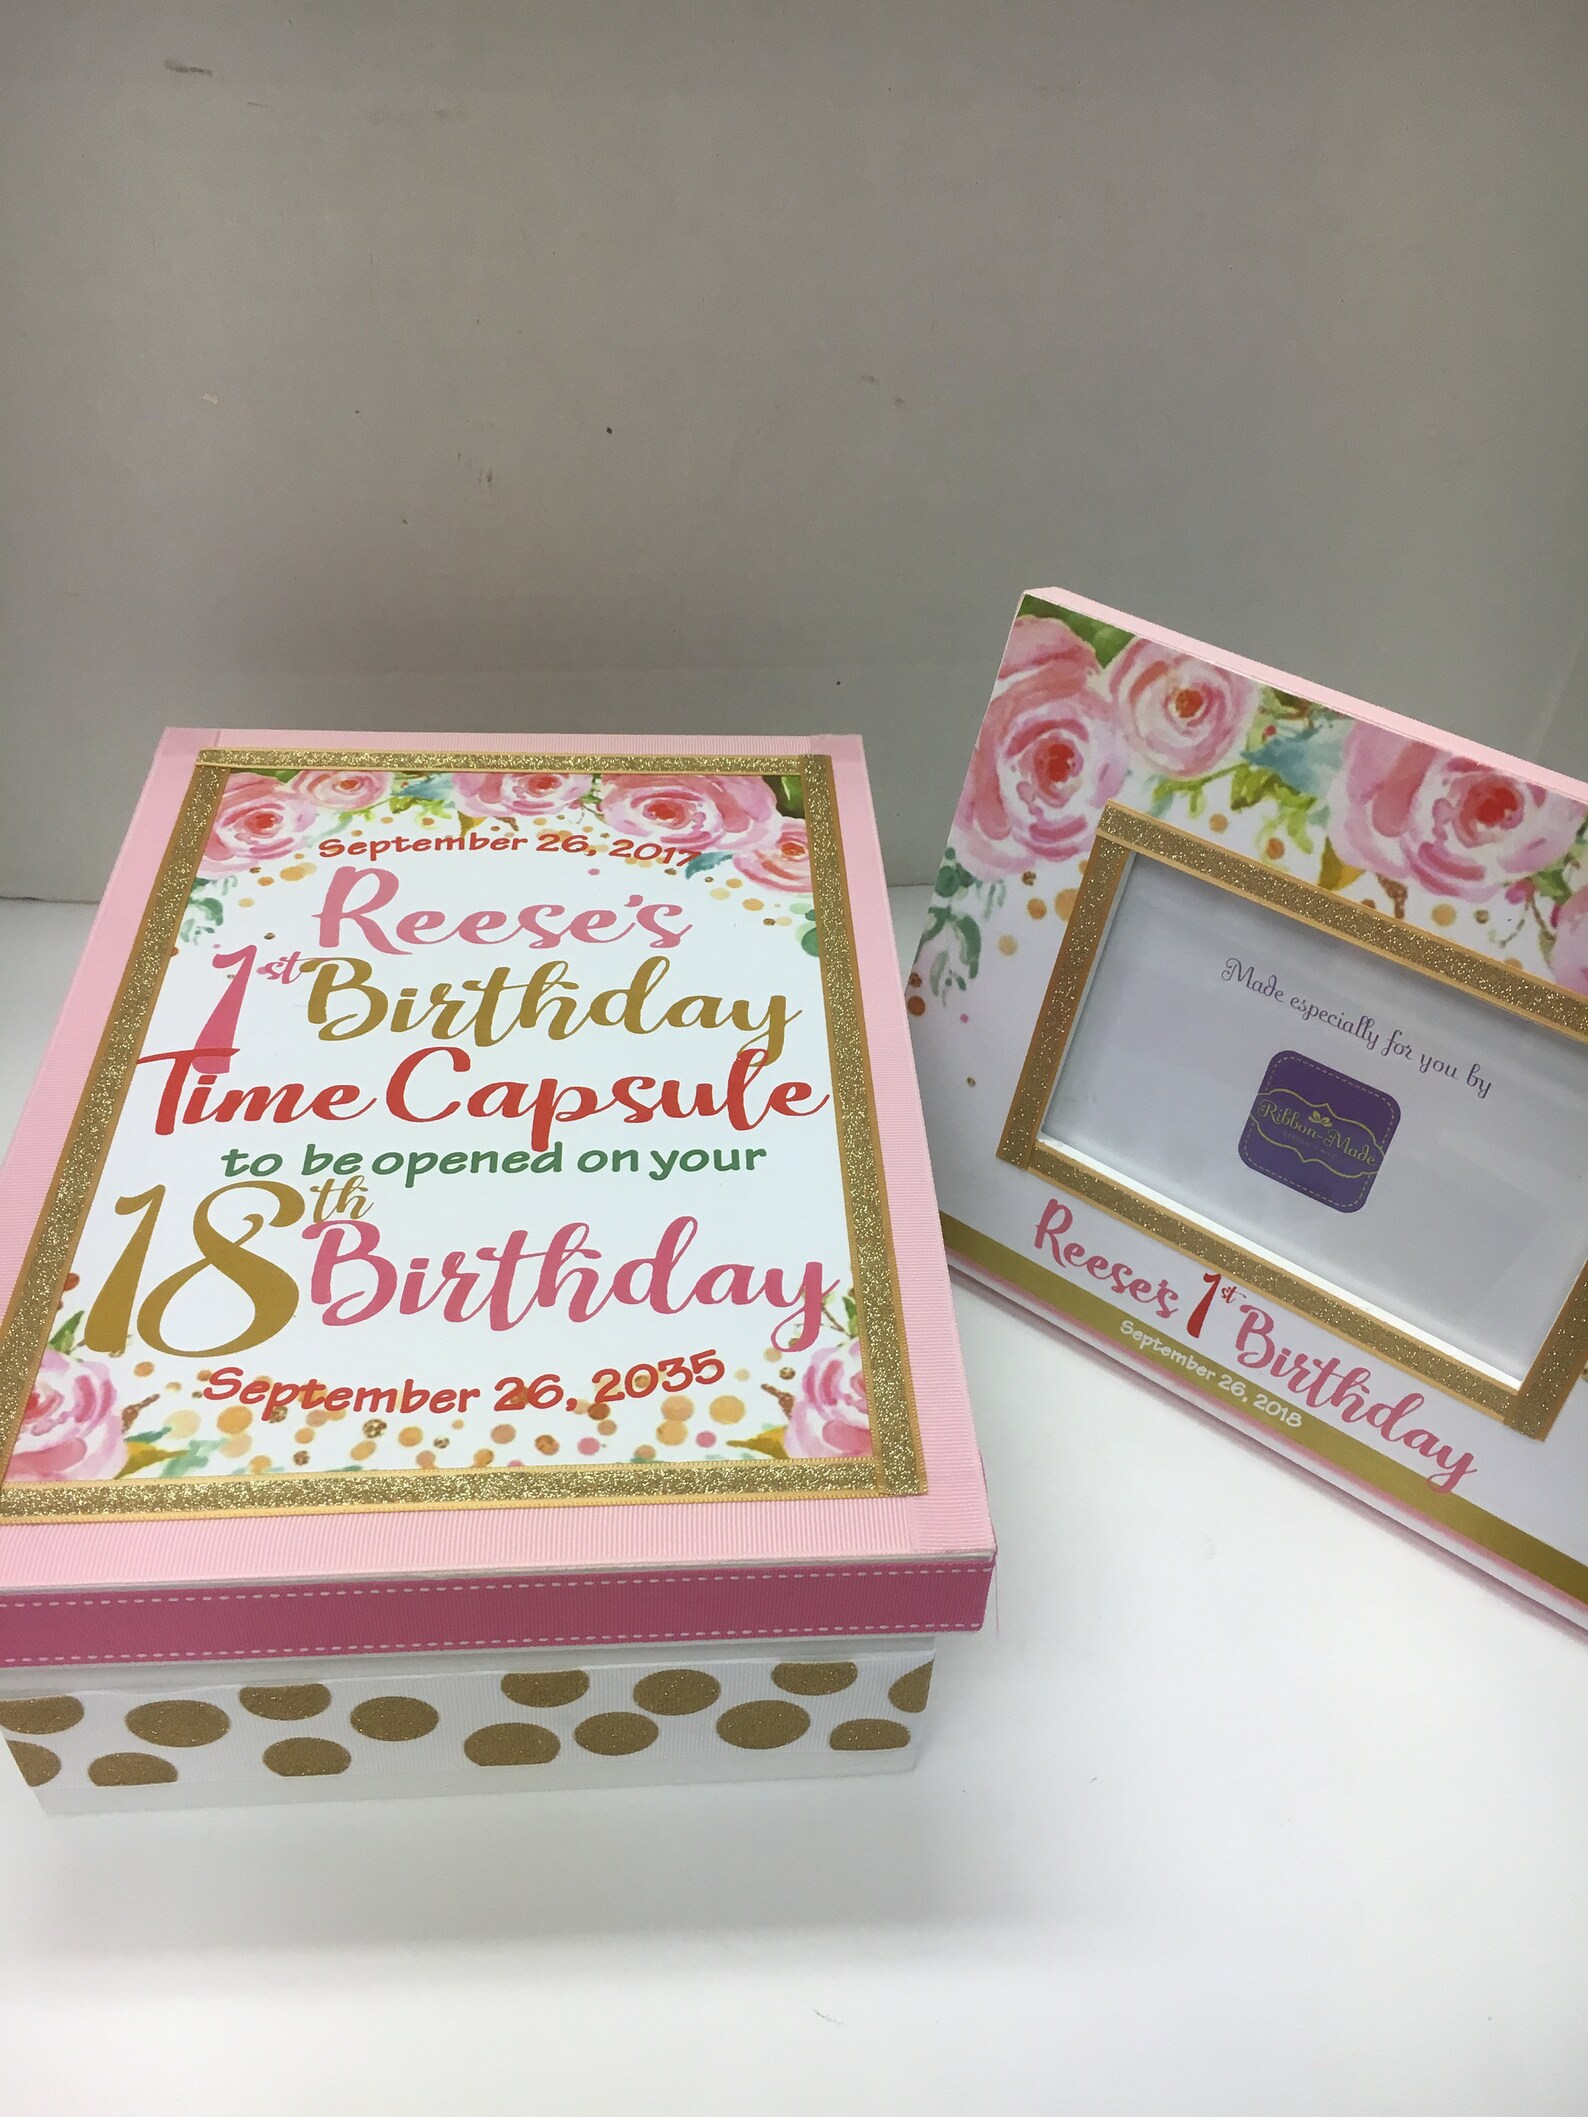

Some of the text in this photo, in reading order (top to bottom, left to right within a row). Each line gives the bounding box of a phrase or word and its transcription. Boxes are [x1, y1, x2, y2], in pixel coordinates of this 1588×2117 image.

[318, 832, 702, 866] September 26, 2017
[312, 866, 693, 955] Reese's
[193, 945, 803, 1074] 1st Birthday
[1221, 957, 1493, 1099] Made especially for you by
[136, 1047, 830, 1151] Time Capsule
[1257, 1099, 1376, 1167] Ribbon-Made
[221, 1141, 767, 1188] to be opened on your
[84, 1175, 841, 1358] 18th Birthday
[203, 1349, 726, 1421] September 26, 2035
[1034, 1198, 1478, 1493] Reese's 1st Birthday
[1120, 1319, 1303, 1428] September 26, 2018
